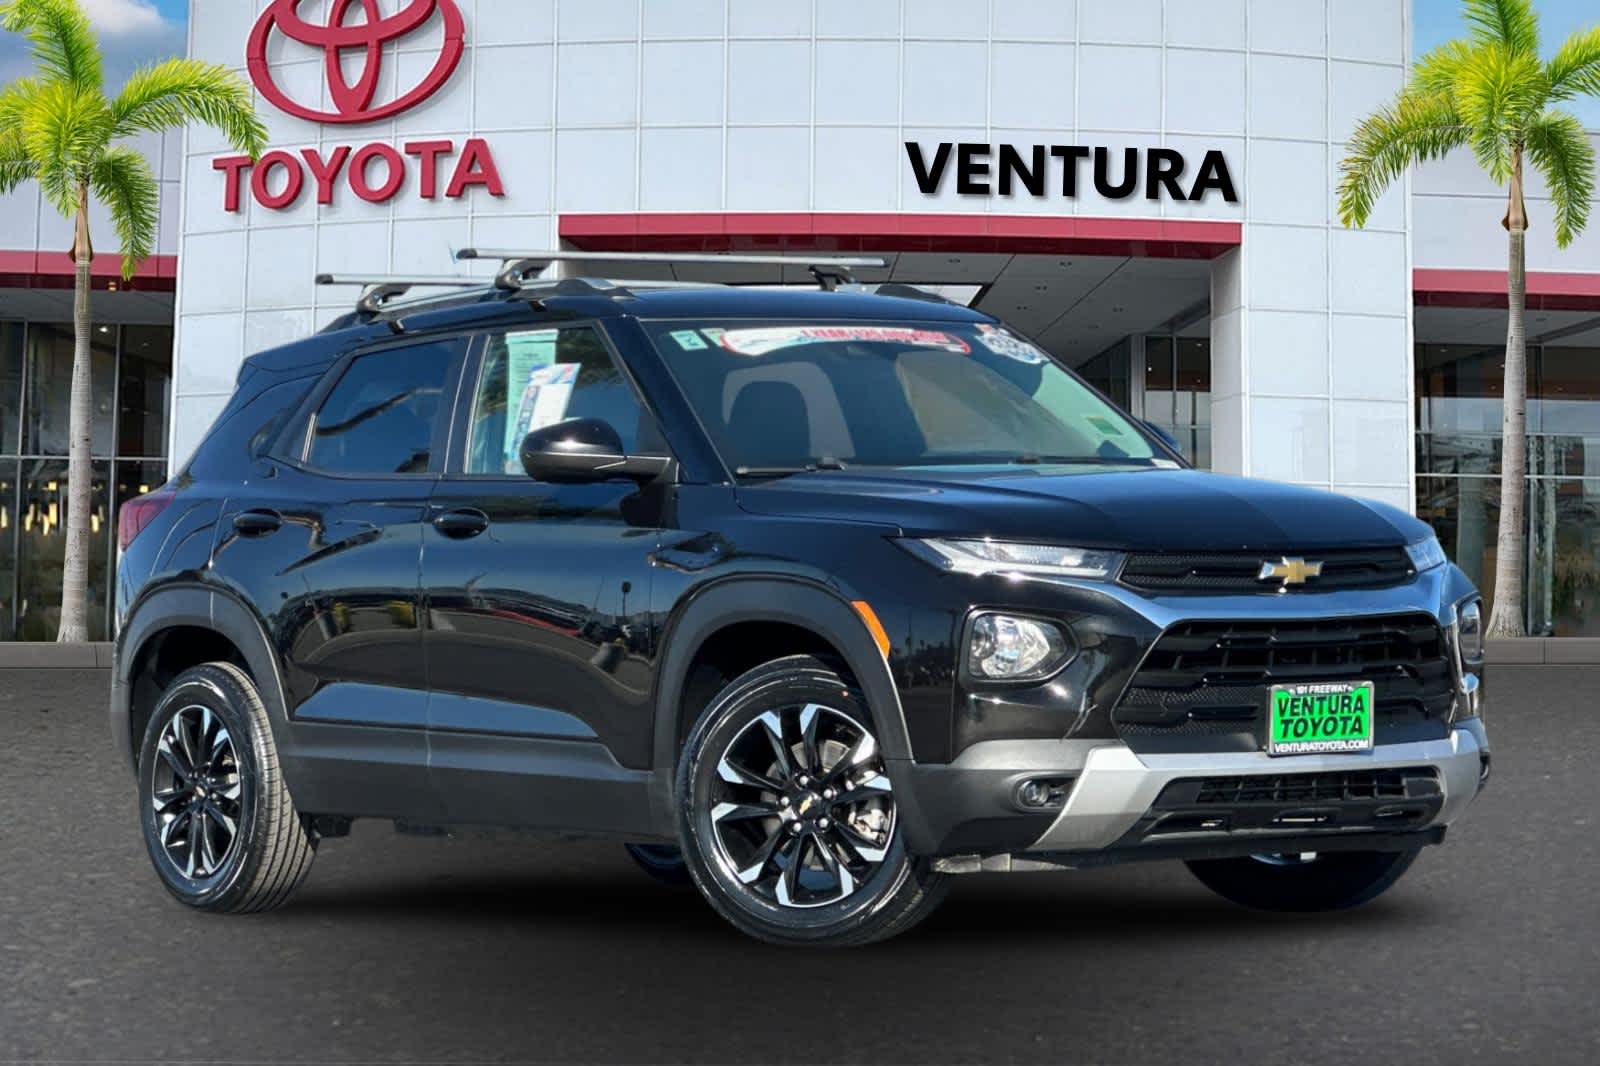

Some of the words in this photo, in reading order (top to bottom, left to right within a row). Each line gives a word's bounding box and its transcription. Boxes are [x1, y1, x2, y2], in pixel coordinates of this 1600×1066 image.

[212, 138, 505, 212] TOYOTA
[904, 141, 1238, 203] VENTURA
[1308, 683, 1348, 694] FREEWAY
[1277, 694, 1365, 717] VENTURA
[1280, 715, 1363, 738] TOYOTA
[1274, 739, 1369, 753] VENTURATOYOTA.COM
